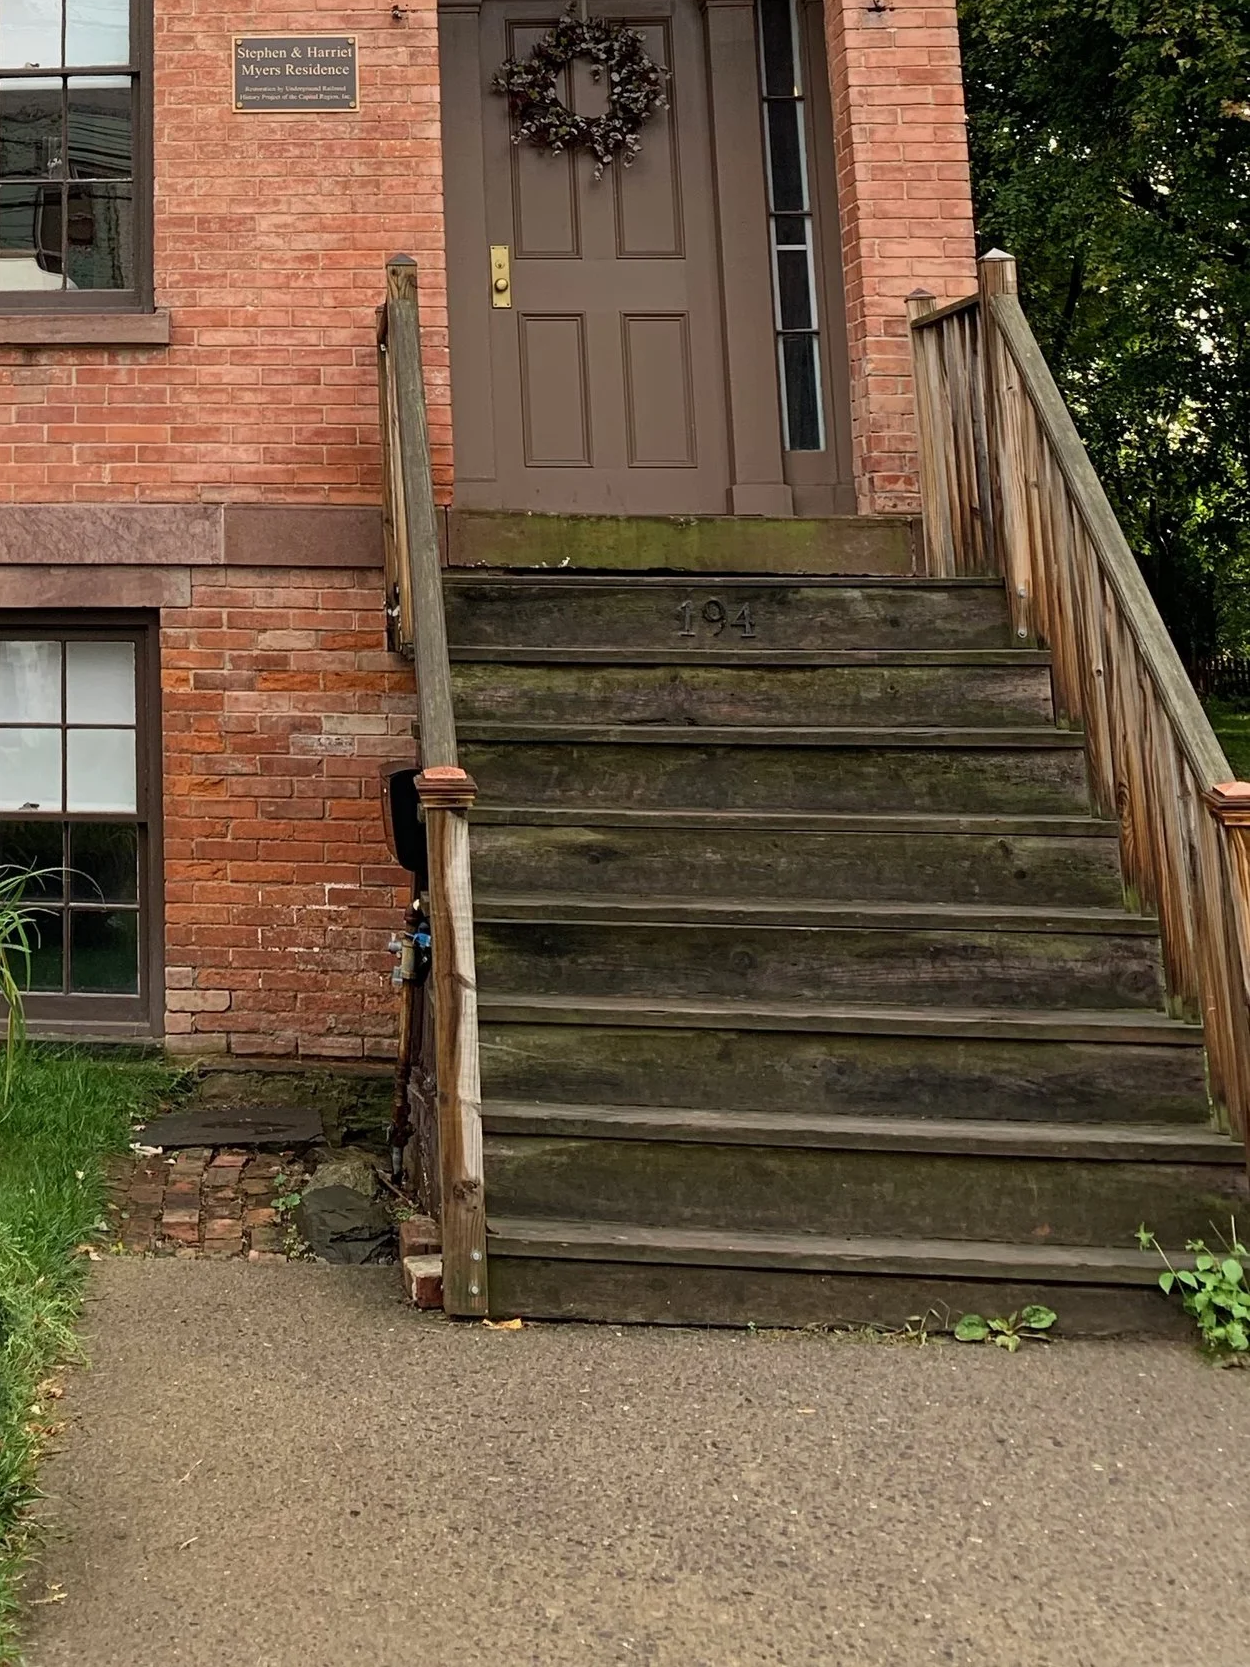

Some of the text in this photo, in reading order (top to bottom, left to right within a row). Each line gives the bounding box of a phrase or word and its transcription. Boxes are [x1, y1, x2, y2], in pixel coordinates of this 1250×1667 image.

[237, 45, 353, 61] Stephen & Harriet
[241, 63, 350, 79] Myers Residence
[677, 597, 756, 638] 194
